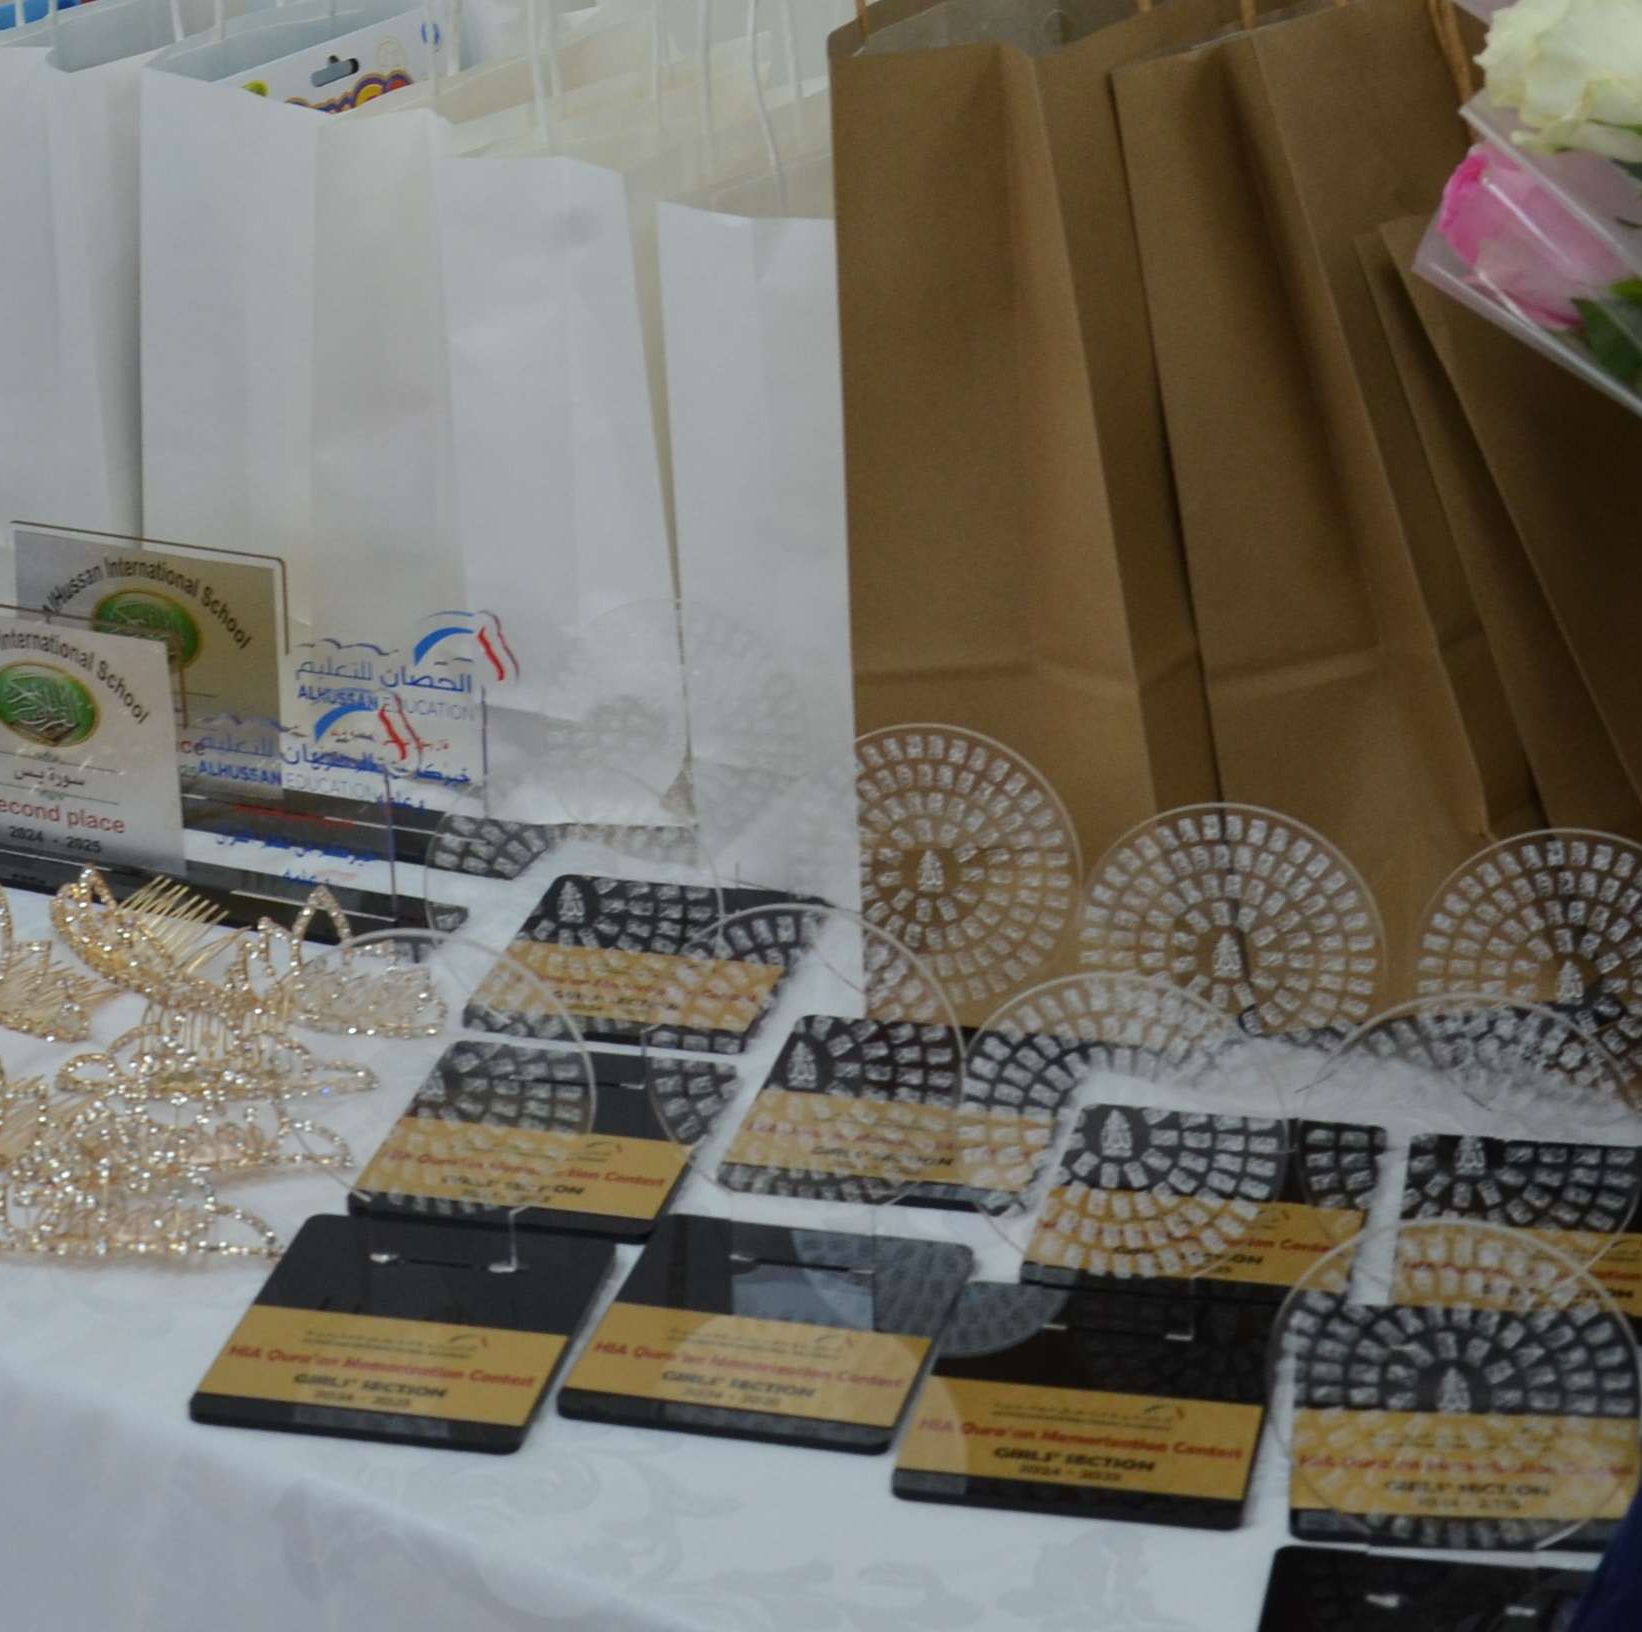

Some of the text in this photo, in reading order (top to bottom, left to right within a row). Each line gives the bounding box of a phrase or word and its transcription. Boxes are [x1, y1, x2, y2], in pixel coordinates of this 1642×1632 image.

[104, 556, 200, 598] International
[200, 586, 254, 650] School
[96, 660, 149, 726] School
[67, 808, 126, 835] place
[9, 825, 45, 843] 2024
[66, 835, 102, 853] 2025
[469, 1369, 537, 1388] Contest
[731, 1377, 817, 1398] SECTION
[836, 1370, 904, 1388] Contest
[362, 1379, 448, 1399] SECTION
[1173, 1441, 1243, 1460] Contest
[1065, 1453, 1156, 1473] SECTION
